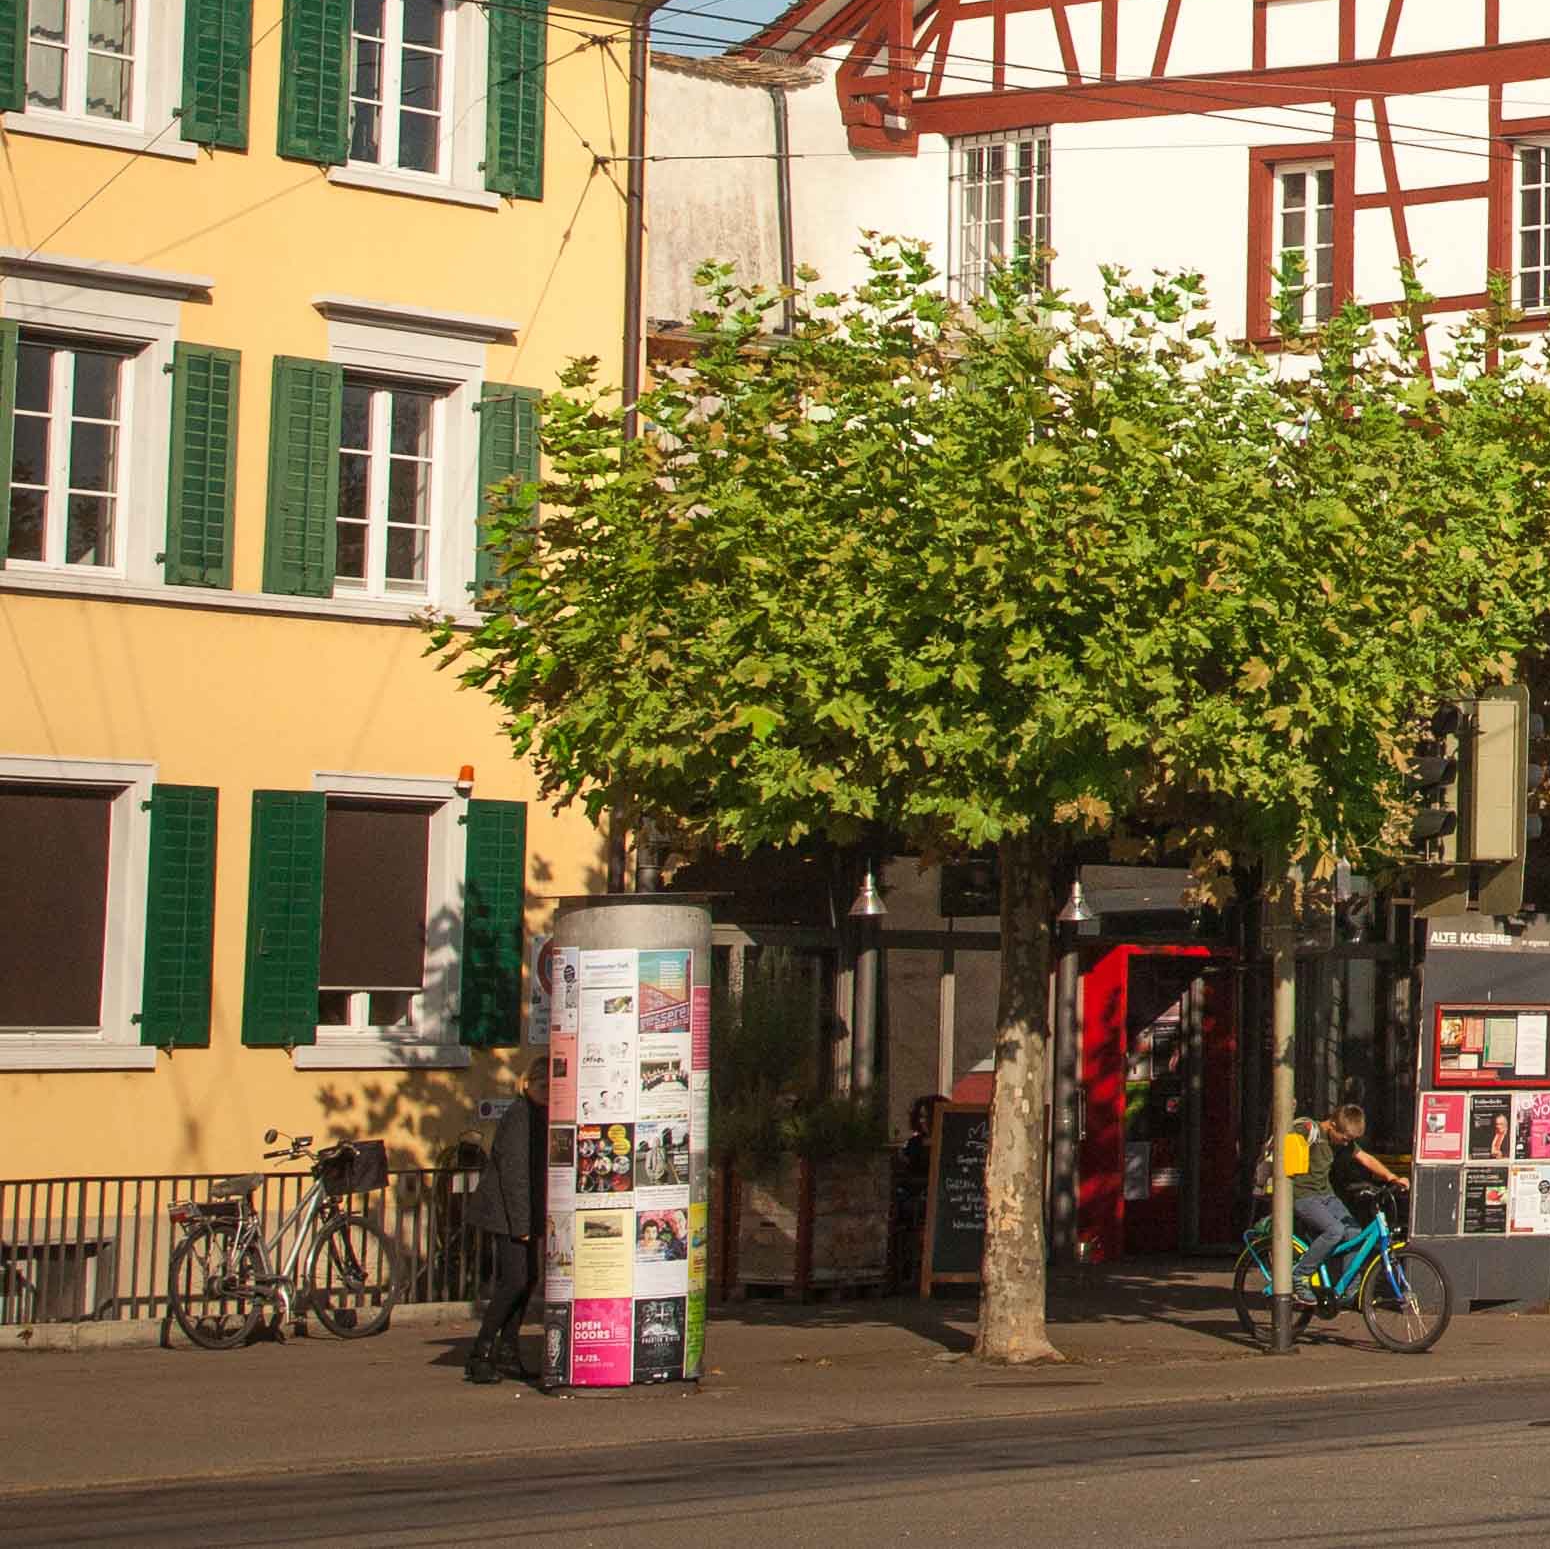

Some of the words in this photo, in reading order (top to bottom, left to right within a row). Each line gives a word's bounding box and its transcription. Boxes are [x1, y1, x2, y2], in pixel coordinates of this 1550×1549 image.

[1430, 931, 1457, 944] ALTE
[1460, 932, 1513, 947] KASERNE
[575, 1321, 601, 1330] OPEN
[575, 1330, 610, 1339] DOORS
